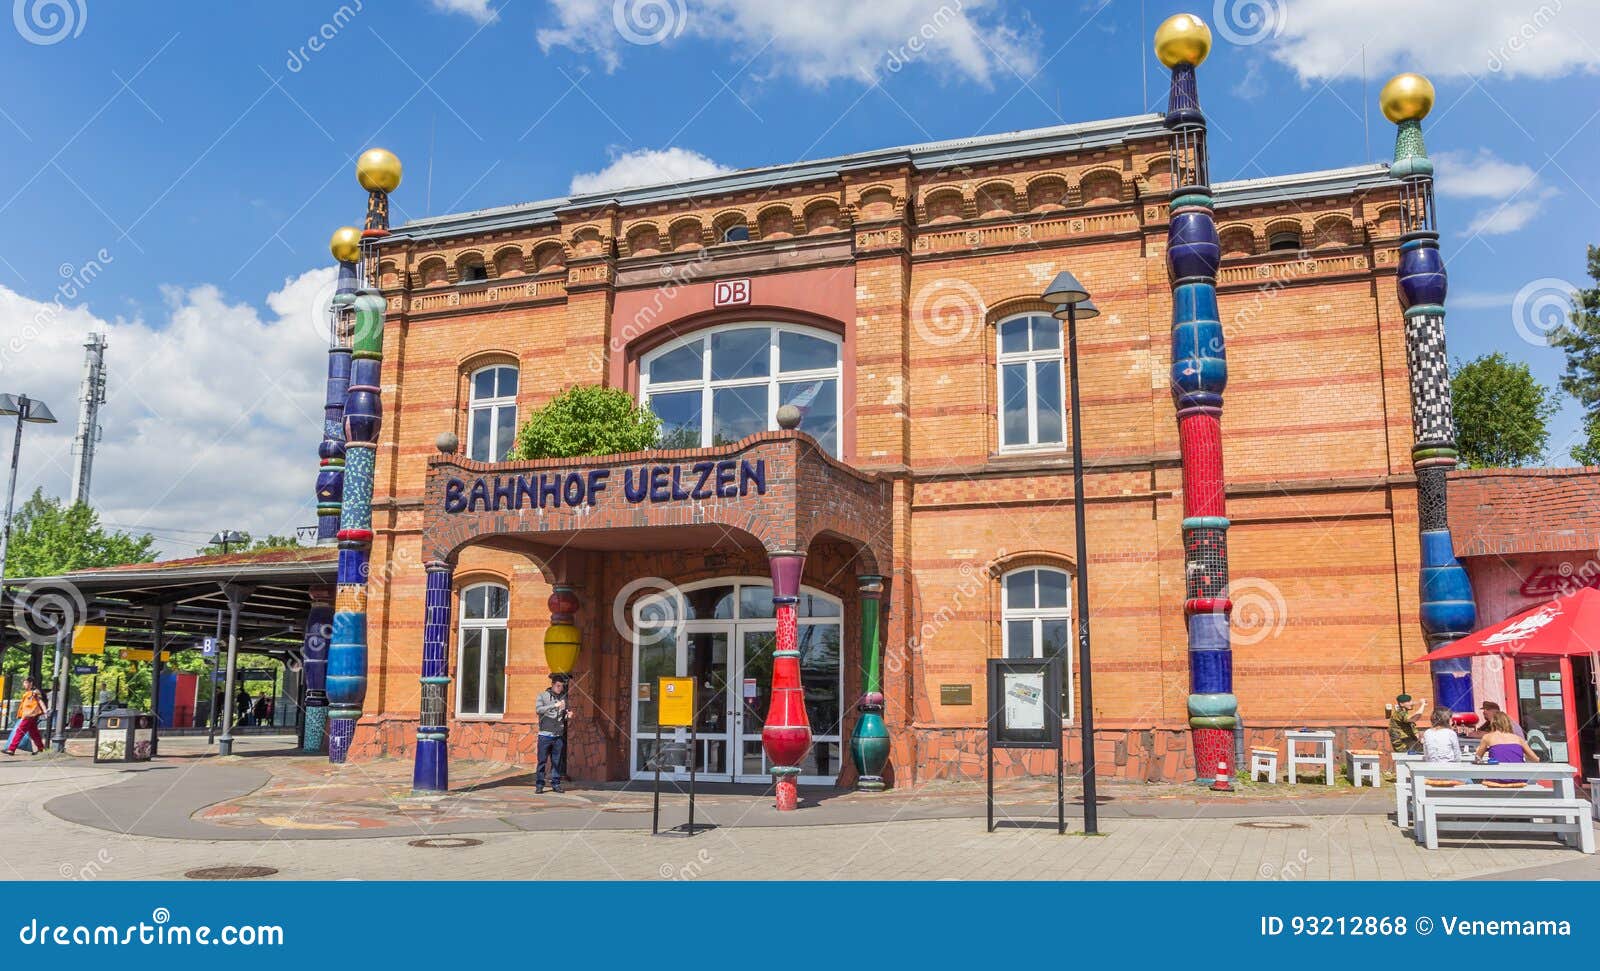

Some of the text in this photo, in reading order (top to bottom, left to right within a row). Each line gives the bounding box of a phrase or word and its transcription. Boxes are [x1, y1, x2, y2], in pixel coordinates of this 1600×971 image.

[717, 281, 747, 304] DB
[445, 459, 766, 514] BAHNHOF UELZEN
[203, 638, 211, 653] B
